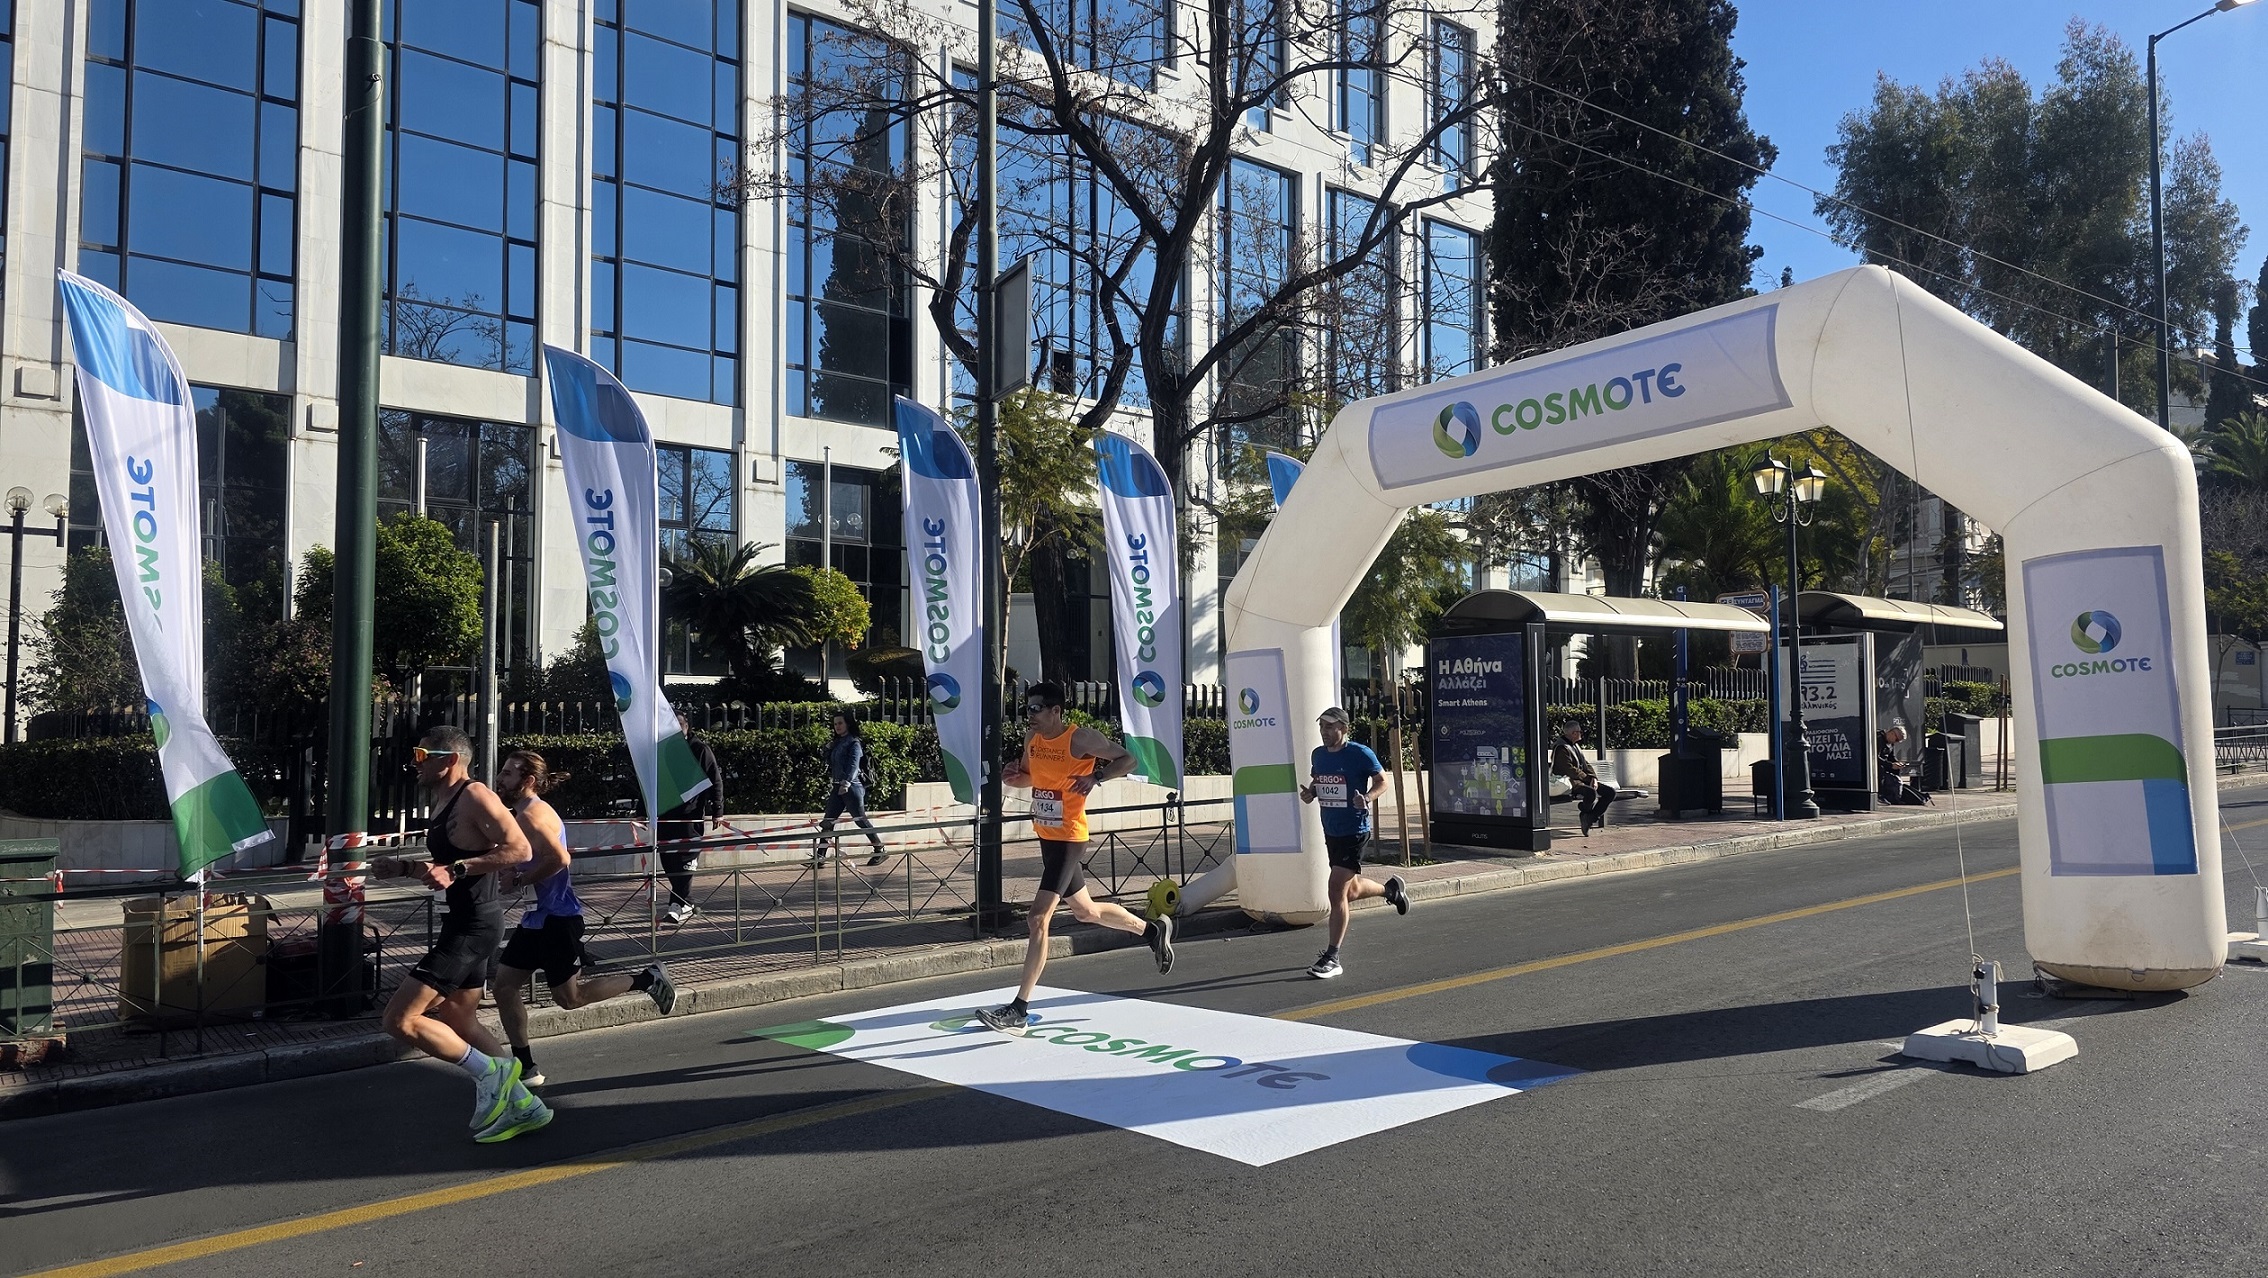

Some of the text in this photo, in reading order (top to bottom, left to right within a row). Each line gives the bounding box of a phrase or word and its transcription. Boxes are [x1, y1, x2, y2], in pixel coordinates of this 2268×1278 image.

[1491, 362, 1686, 435] COSMOTE
[1438, 657, 1502, 677] Η Αθήνα
[2051, 656, 2152, 678] COSMOTE
[1438, 676, 1487, 691] Αλλάζει
[1438, 698, 1488, 707] Smart Athens
[1234, 717, 1276, 730] COSMOTE
[1805, 733, 1848, 745] ΑΙΖΕΙ ΤΑ
[1039, 746, 1066, 755] DISTANCE
[1826, 750, 1852, 760] ΜΑΣ!
[1035, 754, 1066, 762] RUNNERS
[1319, 775, 1340, 783] ERGO
[1034, 789, 1055, 799] ERGO
[1321, 786, 1339, 795] 1042
[1036, 802, 1054, 813] 1134
